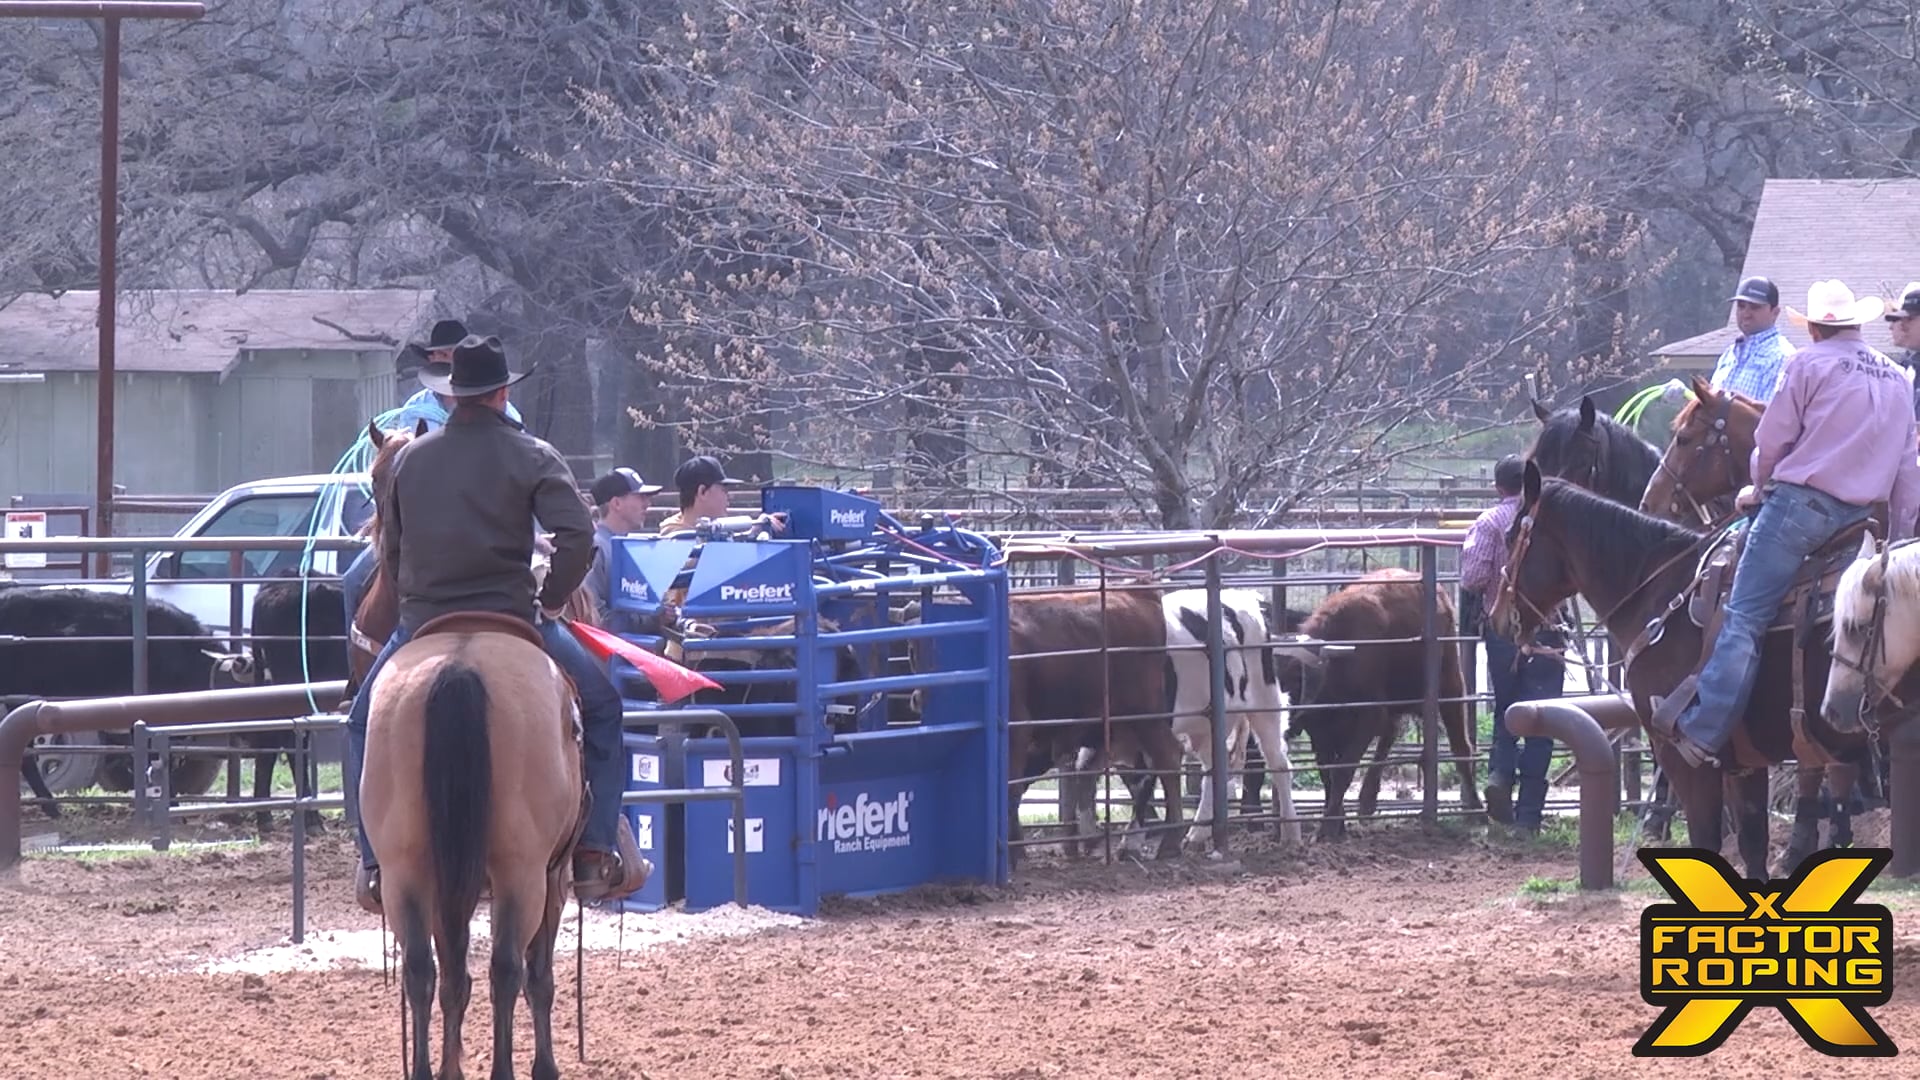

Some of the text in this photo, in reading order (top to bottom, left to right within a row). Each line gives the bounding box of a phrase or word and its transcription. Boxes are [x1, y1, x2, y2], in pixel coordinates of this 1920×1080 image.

[1856, 363, 1898, 380] ARIAT
[720, 583, 791, 600] Priefert
[817, 791, 909, 841] riefert
[834, 834, 910, 853] Ranch Equipment
